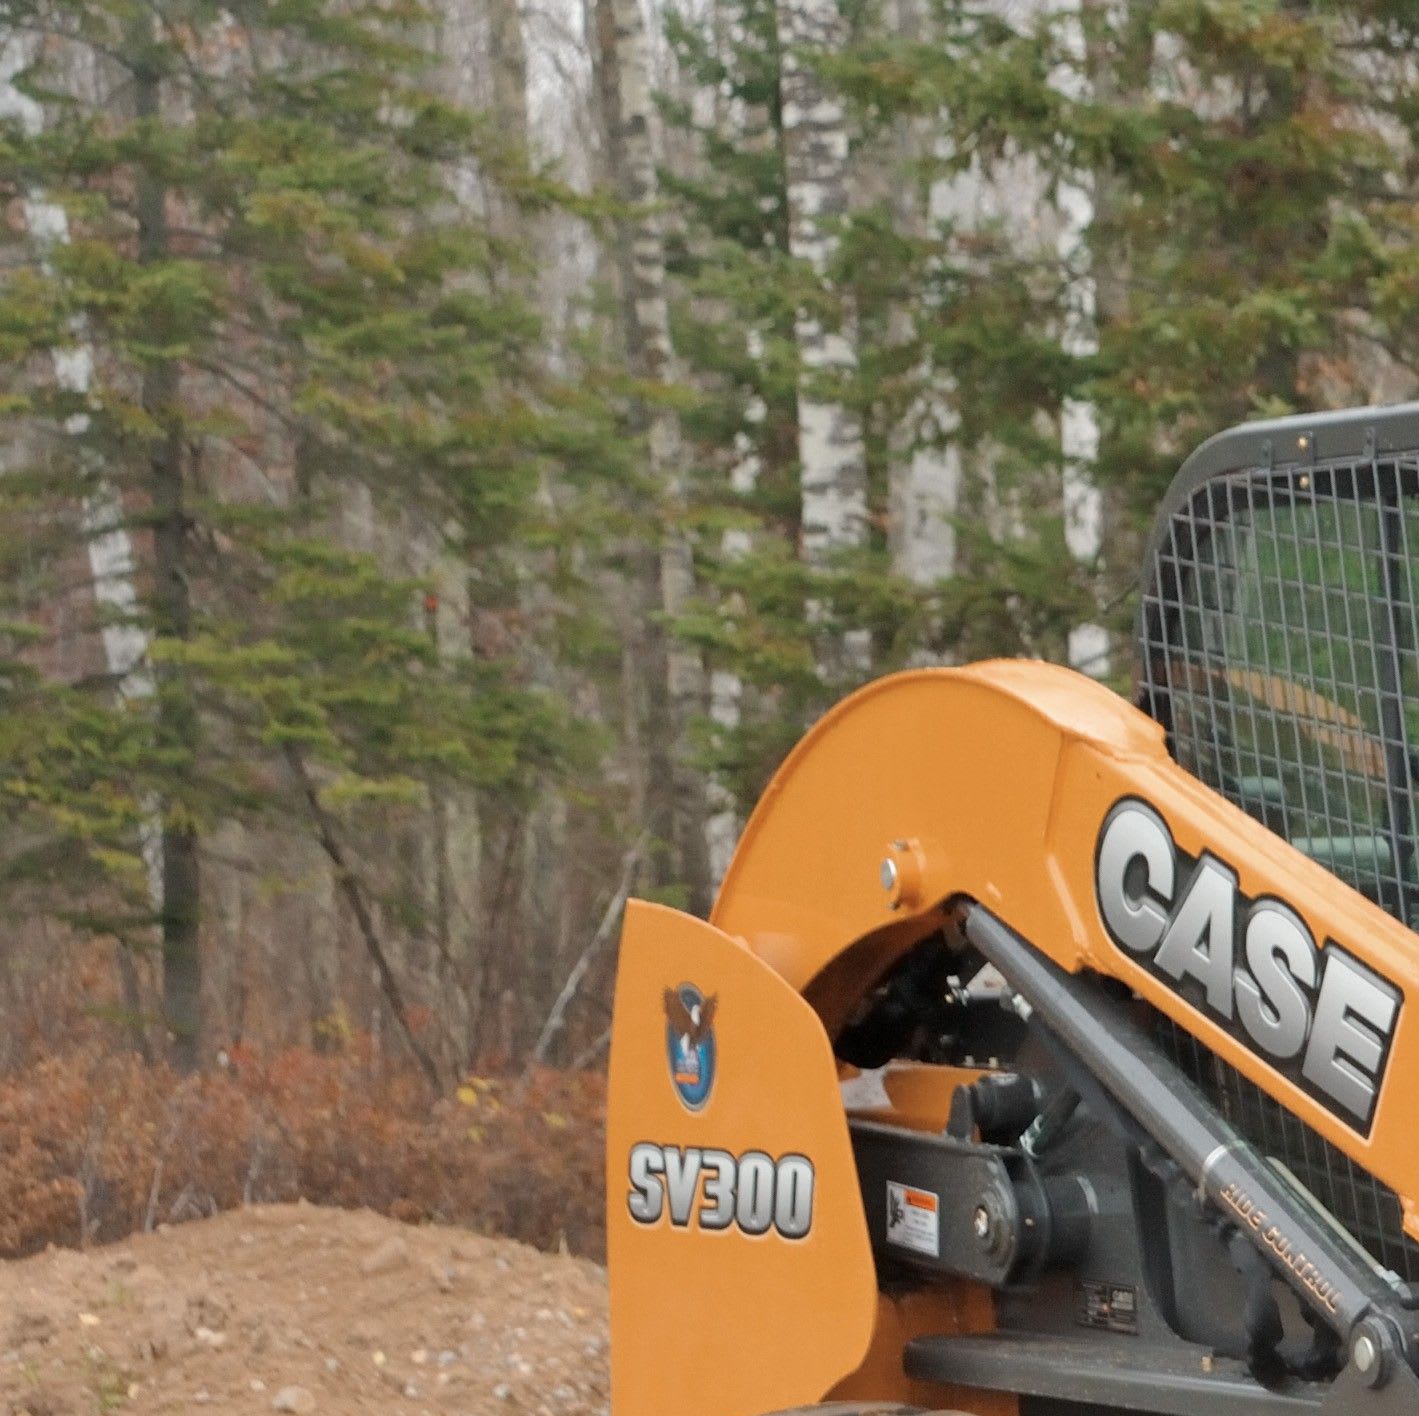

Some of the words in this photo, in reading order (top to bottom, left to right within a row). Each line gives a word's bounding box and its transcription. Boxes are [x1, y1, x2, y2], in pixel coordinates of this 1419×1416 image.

[1097, 797, 1403, 1123] CASE
[628, 1141, 814, 1239] SV300
[1220, 1183, 1268, 1231] RIDE
[1261, 1226, 1344, 1314] CONTROL
